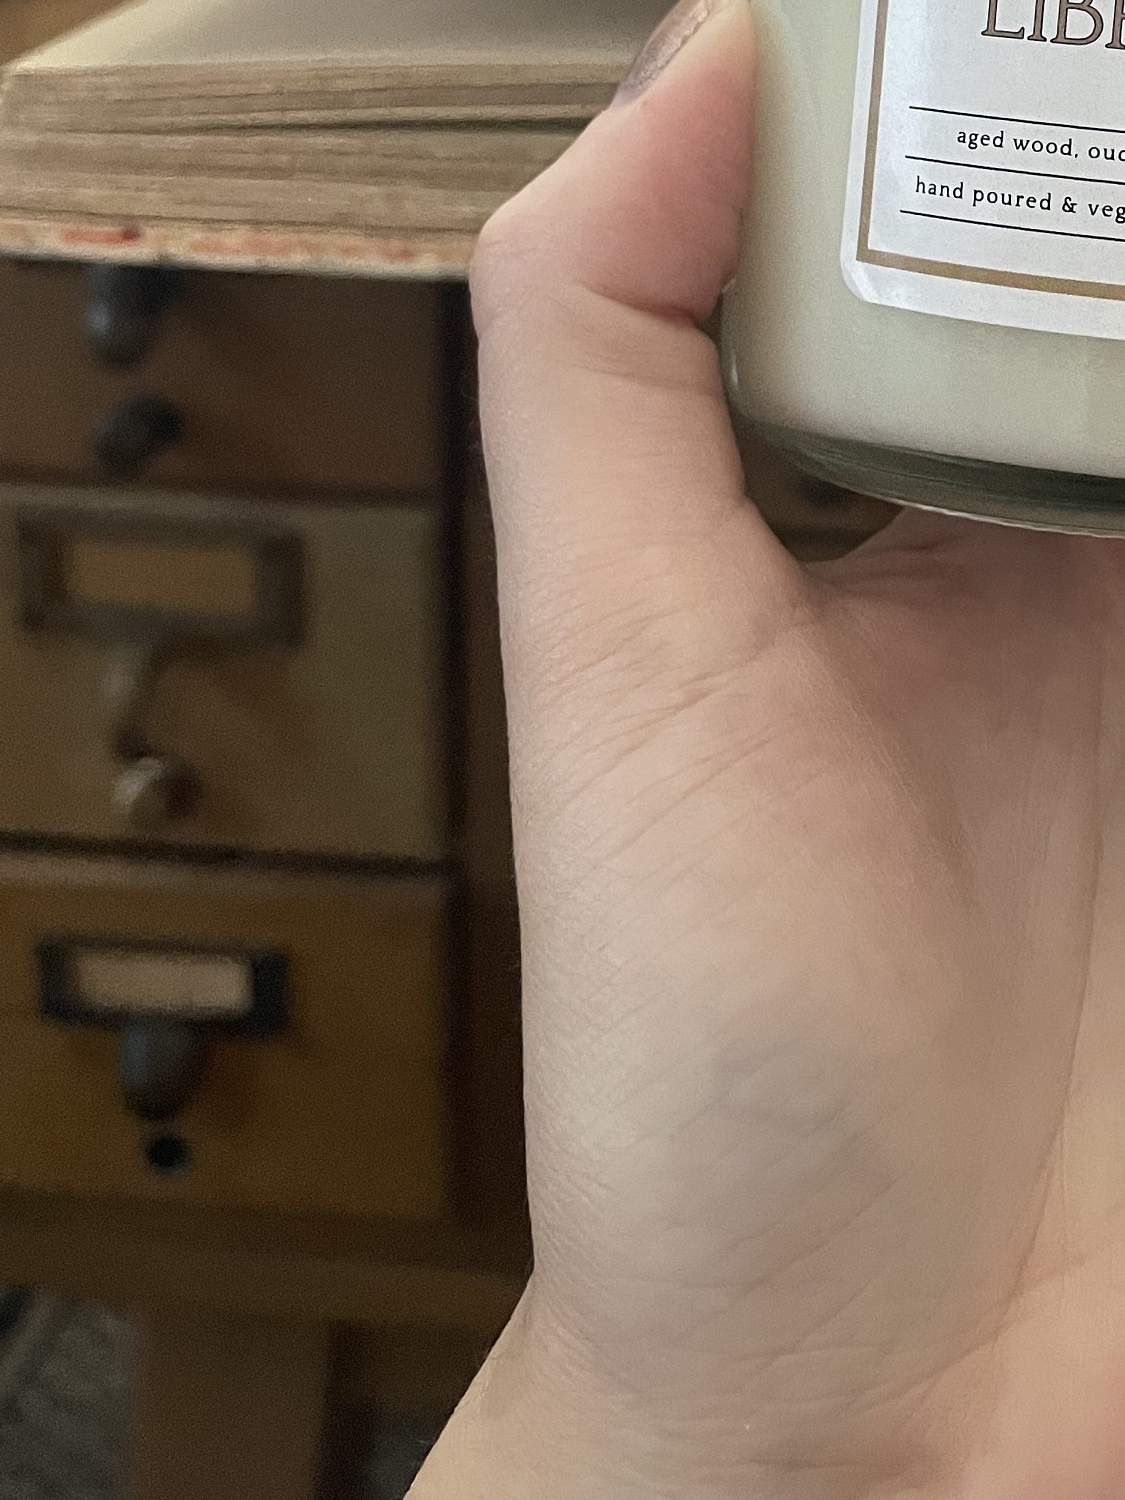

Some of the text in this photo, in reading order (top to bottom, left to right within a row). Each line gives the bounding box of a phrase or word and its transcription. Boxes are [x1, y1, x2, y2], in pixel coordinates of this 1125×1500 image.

[957, 130, 1004, 150] aged
[1012, 137, 1079, 159] wood,
[915, 175, 963, 199] hand
[972, 189, 1051, 211] poured
[1062, 196, 1078, 213] &
